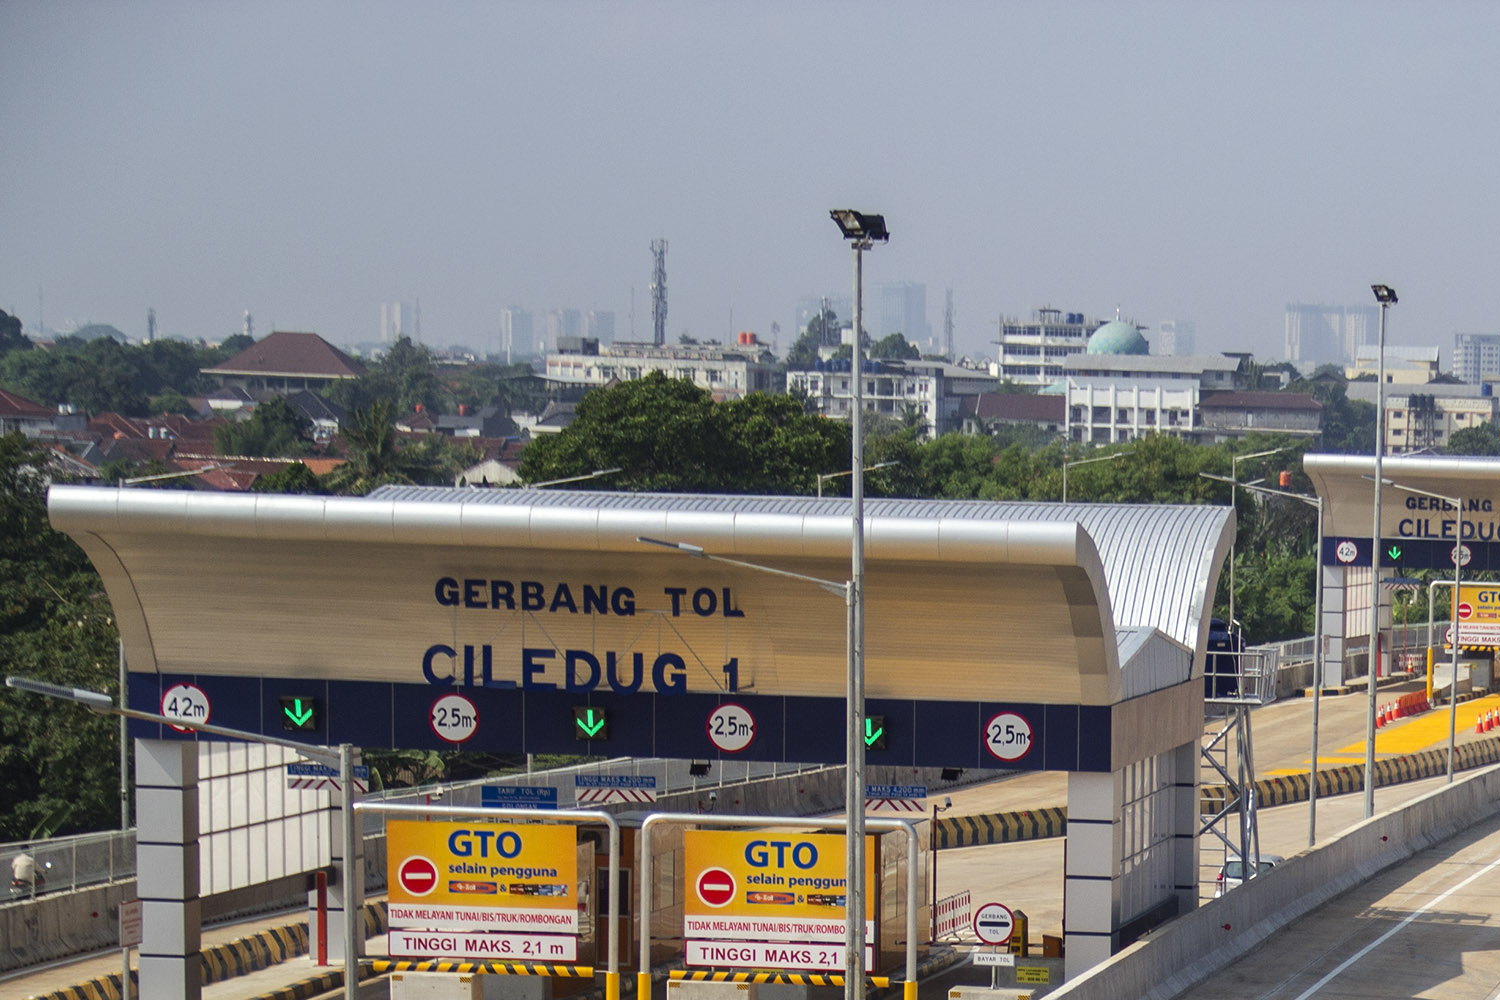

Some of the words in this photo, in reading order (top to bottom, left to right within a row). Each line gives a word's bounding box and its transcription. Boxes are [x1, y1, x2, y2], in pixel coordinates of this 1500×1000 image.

[435, 577, 636, 617] GERBANG
[664, 587, 746, 618] TOL
[422, 644, 687, 695] CILEDUG
[722, 657, 740, 693] 1
[437, 707, 473, 729] 2,5m
[714, 716, 749, 738] 2,5m
[992, 725, 1027, 748] 2,5m
[448, 829, 523, 859] GTO
[744, 840, 819, 870] GTO
[448, 862, 487, 876] selain
[490, 866, 558, 879] pengguna
[746, 873, 785, 886] selain
[788, 876, 847, 889] penggun
[390, 908, 415, 920] TIDAK
[415, 910, 454, 921] MELAYANI
[455, 911, 573, 925] TUNAI/BIS/TRUK/ROMBONGAN
[687, 920, 712, 931] TIDAK
[712, 921, 751, 932] MELAYANI
[403, 937, 457, 952] TINGGI
[465, 939, 515, 953] MAKS.
[522, 941, 543, 956] 2,1
[550, 943, 564, 955] m
[700, 947, 757, 962] TINGGI
[765, 949, 814, 964] MAKS.
[819, 951, 838, 966] 2,1
